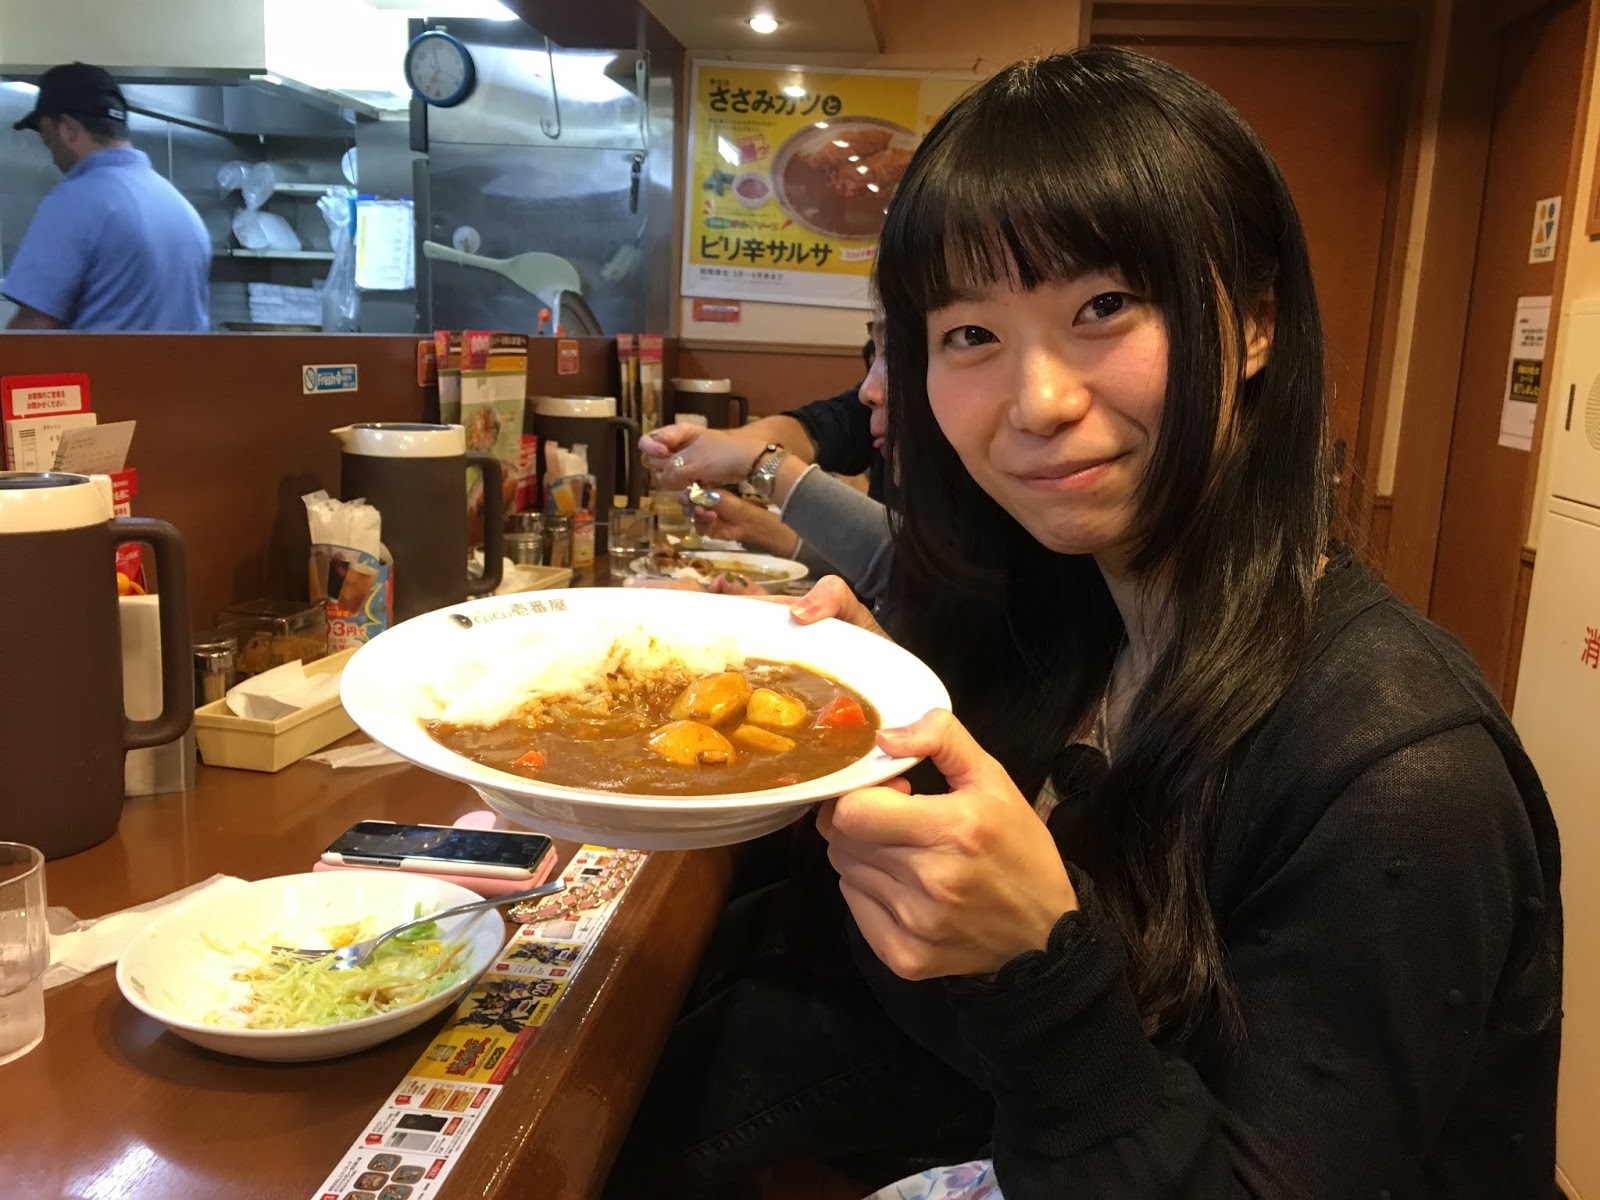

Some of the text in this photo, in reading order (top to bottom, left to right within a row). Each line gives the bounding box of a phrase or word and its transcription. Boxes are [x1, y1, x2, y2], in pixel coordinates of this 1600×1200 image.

[709, 86, 842, 116] ささみカツと
[701, 235, 833, 267] ピリ辛サルサ
